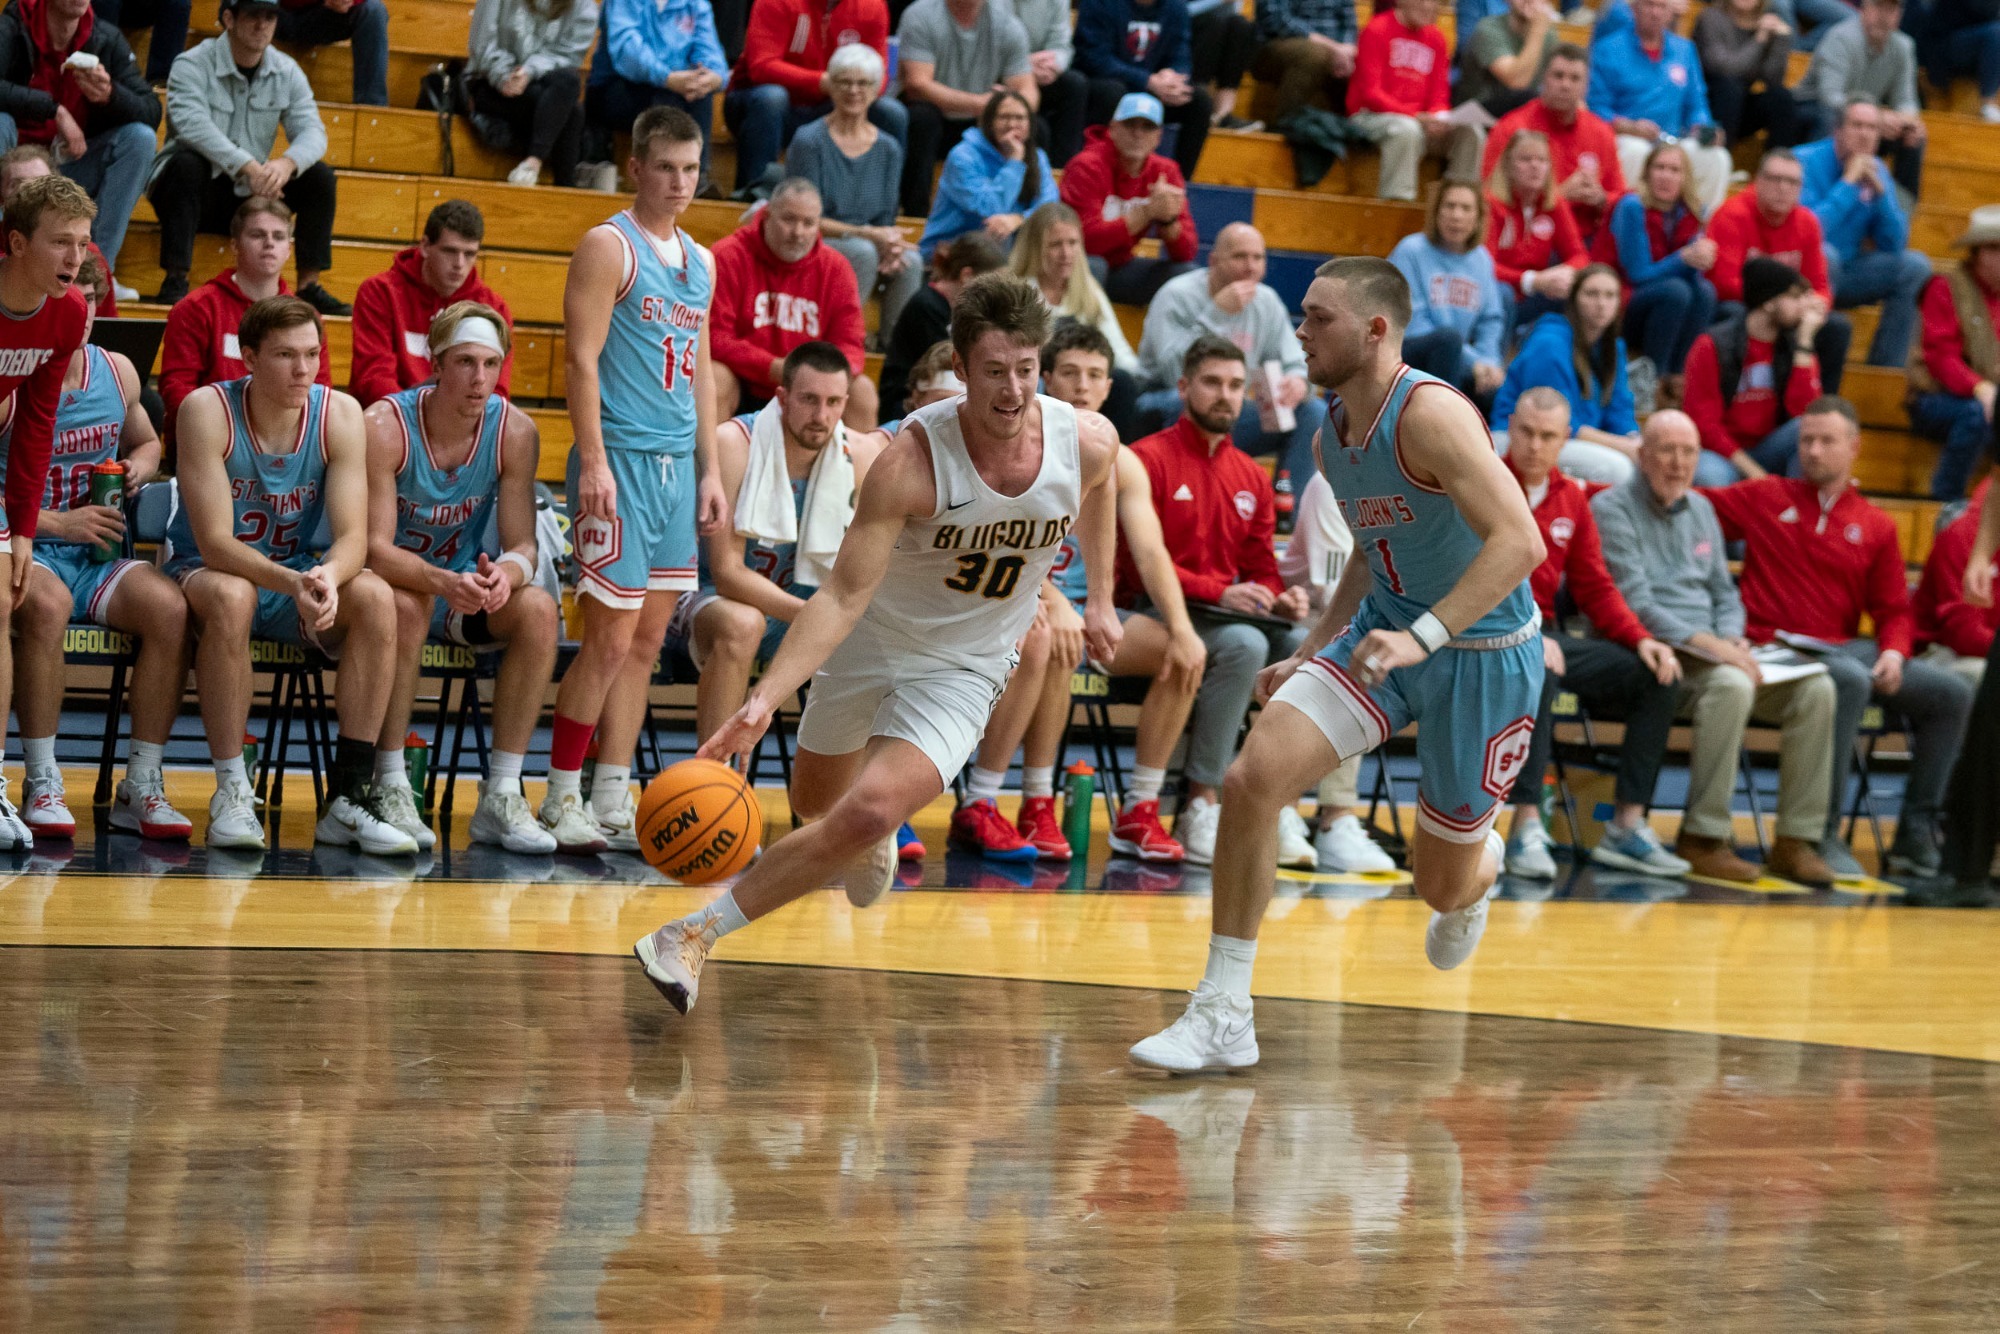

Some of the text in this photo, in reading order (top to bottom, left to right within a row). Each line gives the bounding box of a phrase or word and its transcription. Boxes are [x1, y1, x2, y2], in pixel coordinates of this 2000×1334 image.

[641, 295, 707, 332] ST. JOHN
[0, 348, 54, 377] OHN'S
[659, 333, 696, 395] 14
[53, 421, 120, 456] JOHN'S
[47, 461, 98, 511] 10
[230, 477, 259, 502] ST.
[1355, 493, 1417, 529] JOHN'S
[233, 508, 301, 562] 25
[943, 550, 1028, 600] 30
[1374, 537, 1407, 596] 1
[62, 629, 133, 654] UGOLDS
[250, 640, 306, 664] GOLDS
[420, 643, 477, 668] GOLDS
[650, 804, 700, 853] NCAA
